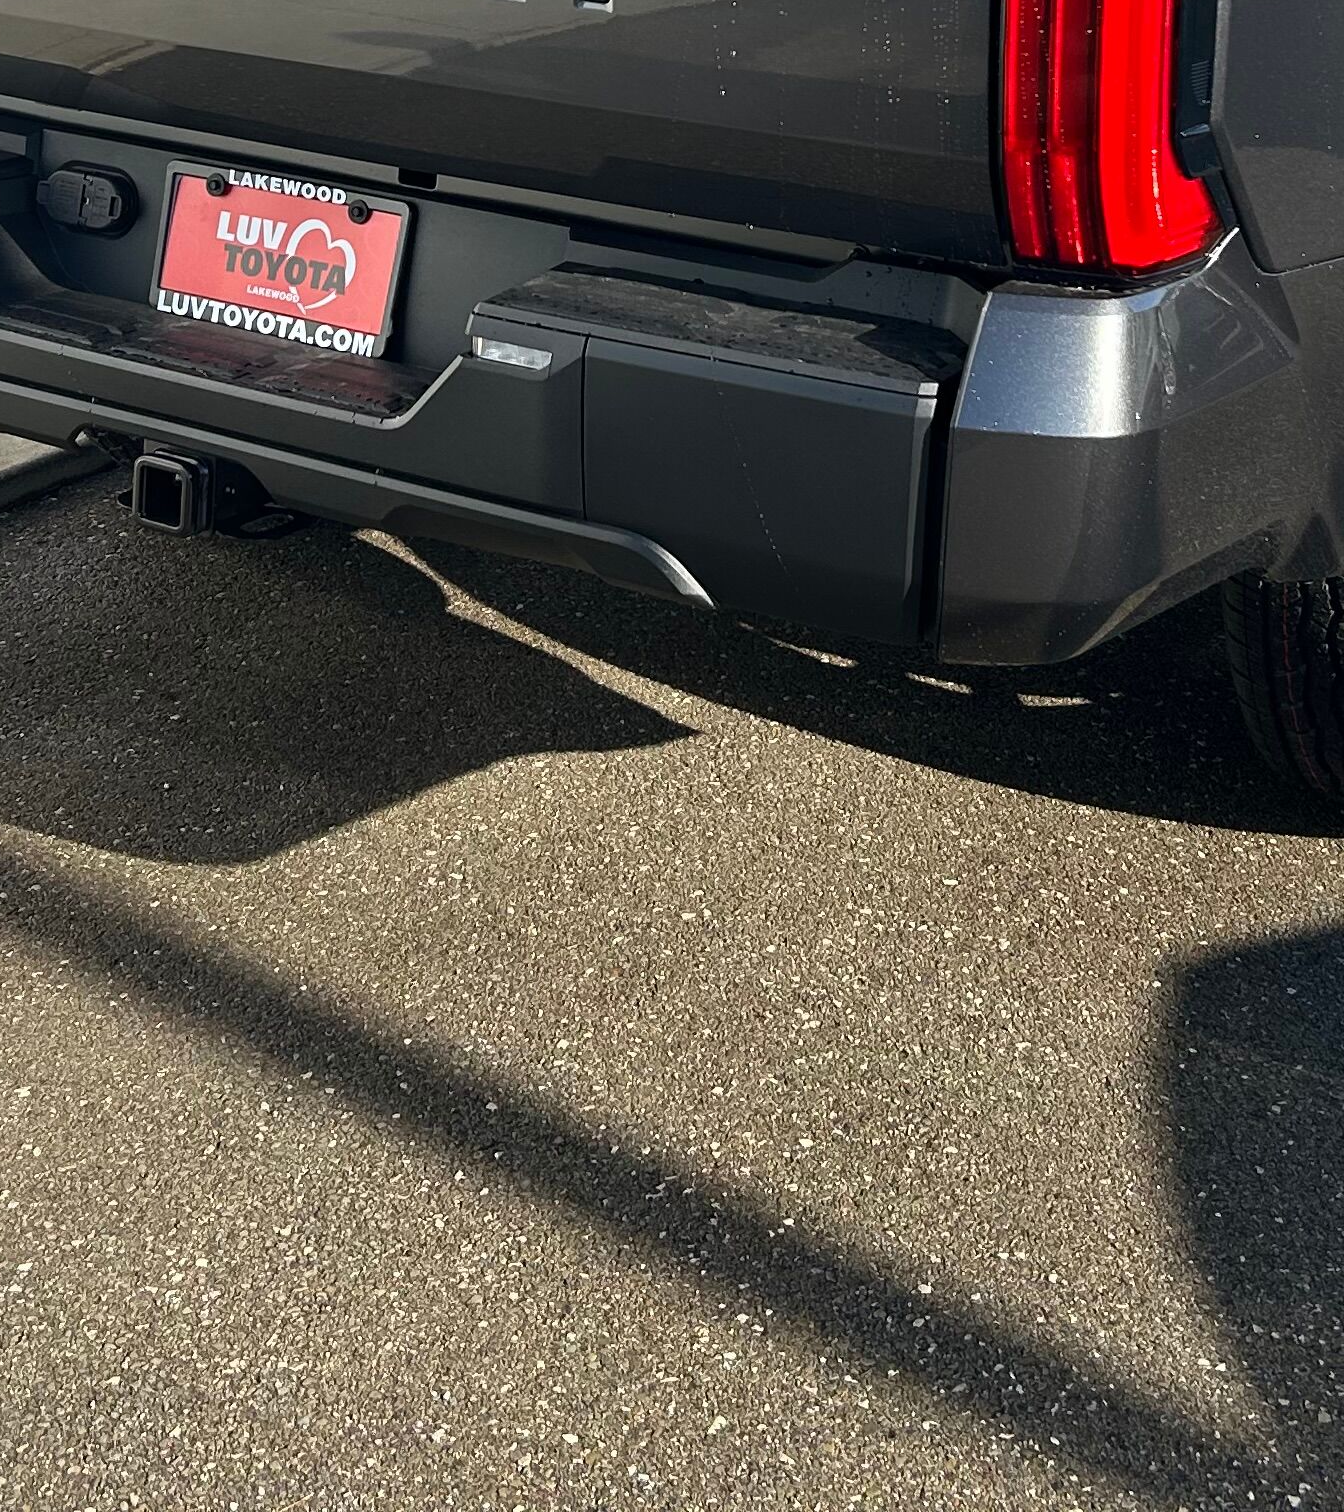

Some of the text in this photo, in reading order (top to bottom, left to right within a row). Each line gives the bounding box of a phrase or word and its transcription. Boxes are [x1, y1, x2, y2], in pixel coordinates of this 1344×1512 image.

[228, 169, 347, 205] LAKEWOOD
[216, 210, 288, 250] LUV
[224, 243, 346, 296] TOYOTA
[246, 284, 300, 303] LAKEWOOD
[156, 289, 376, 357] LUVTOYOTA.COM
